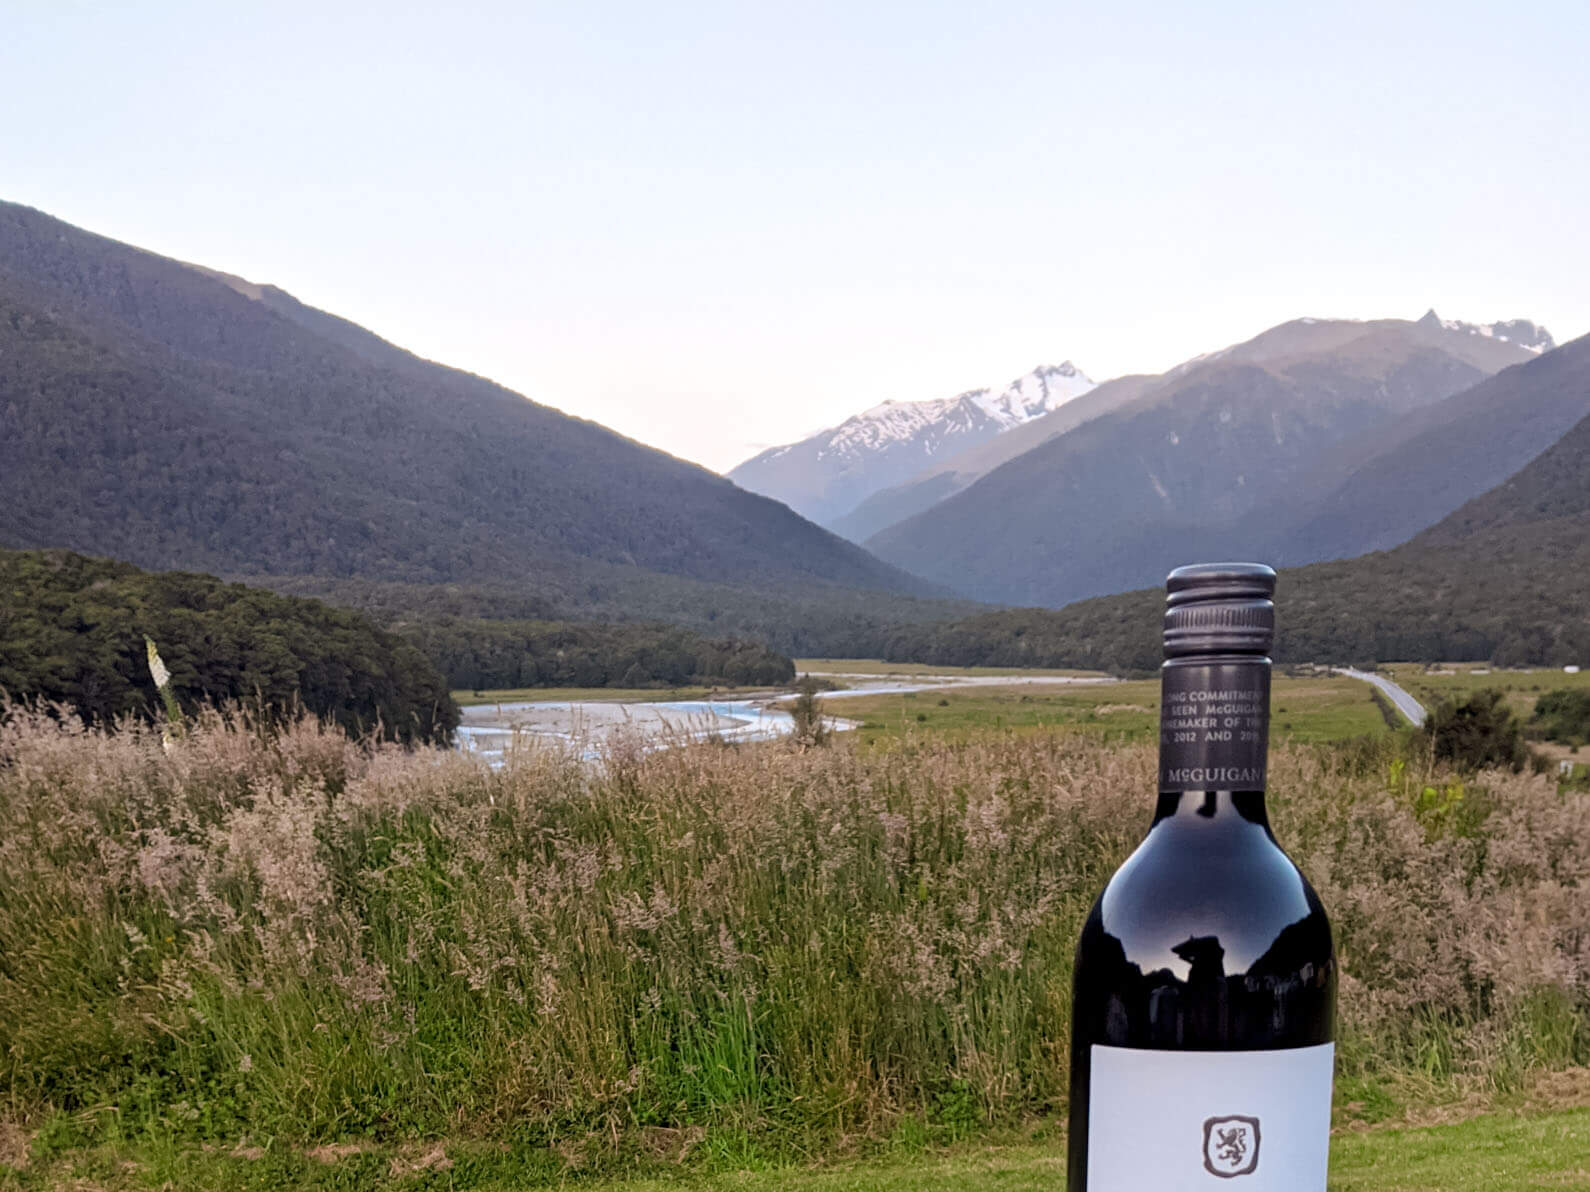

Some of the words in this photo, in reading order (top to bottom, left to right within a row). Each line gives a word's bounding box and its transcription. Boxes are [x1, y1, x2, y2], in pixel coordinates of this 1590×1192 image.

[1223, 717, 1241, 728] OF
[1204, 730, 1233, 742] AND
[1168, 768, 1261, 782] McGUIGAN
